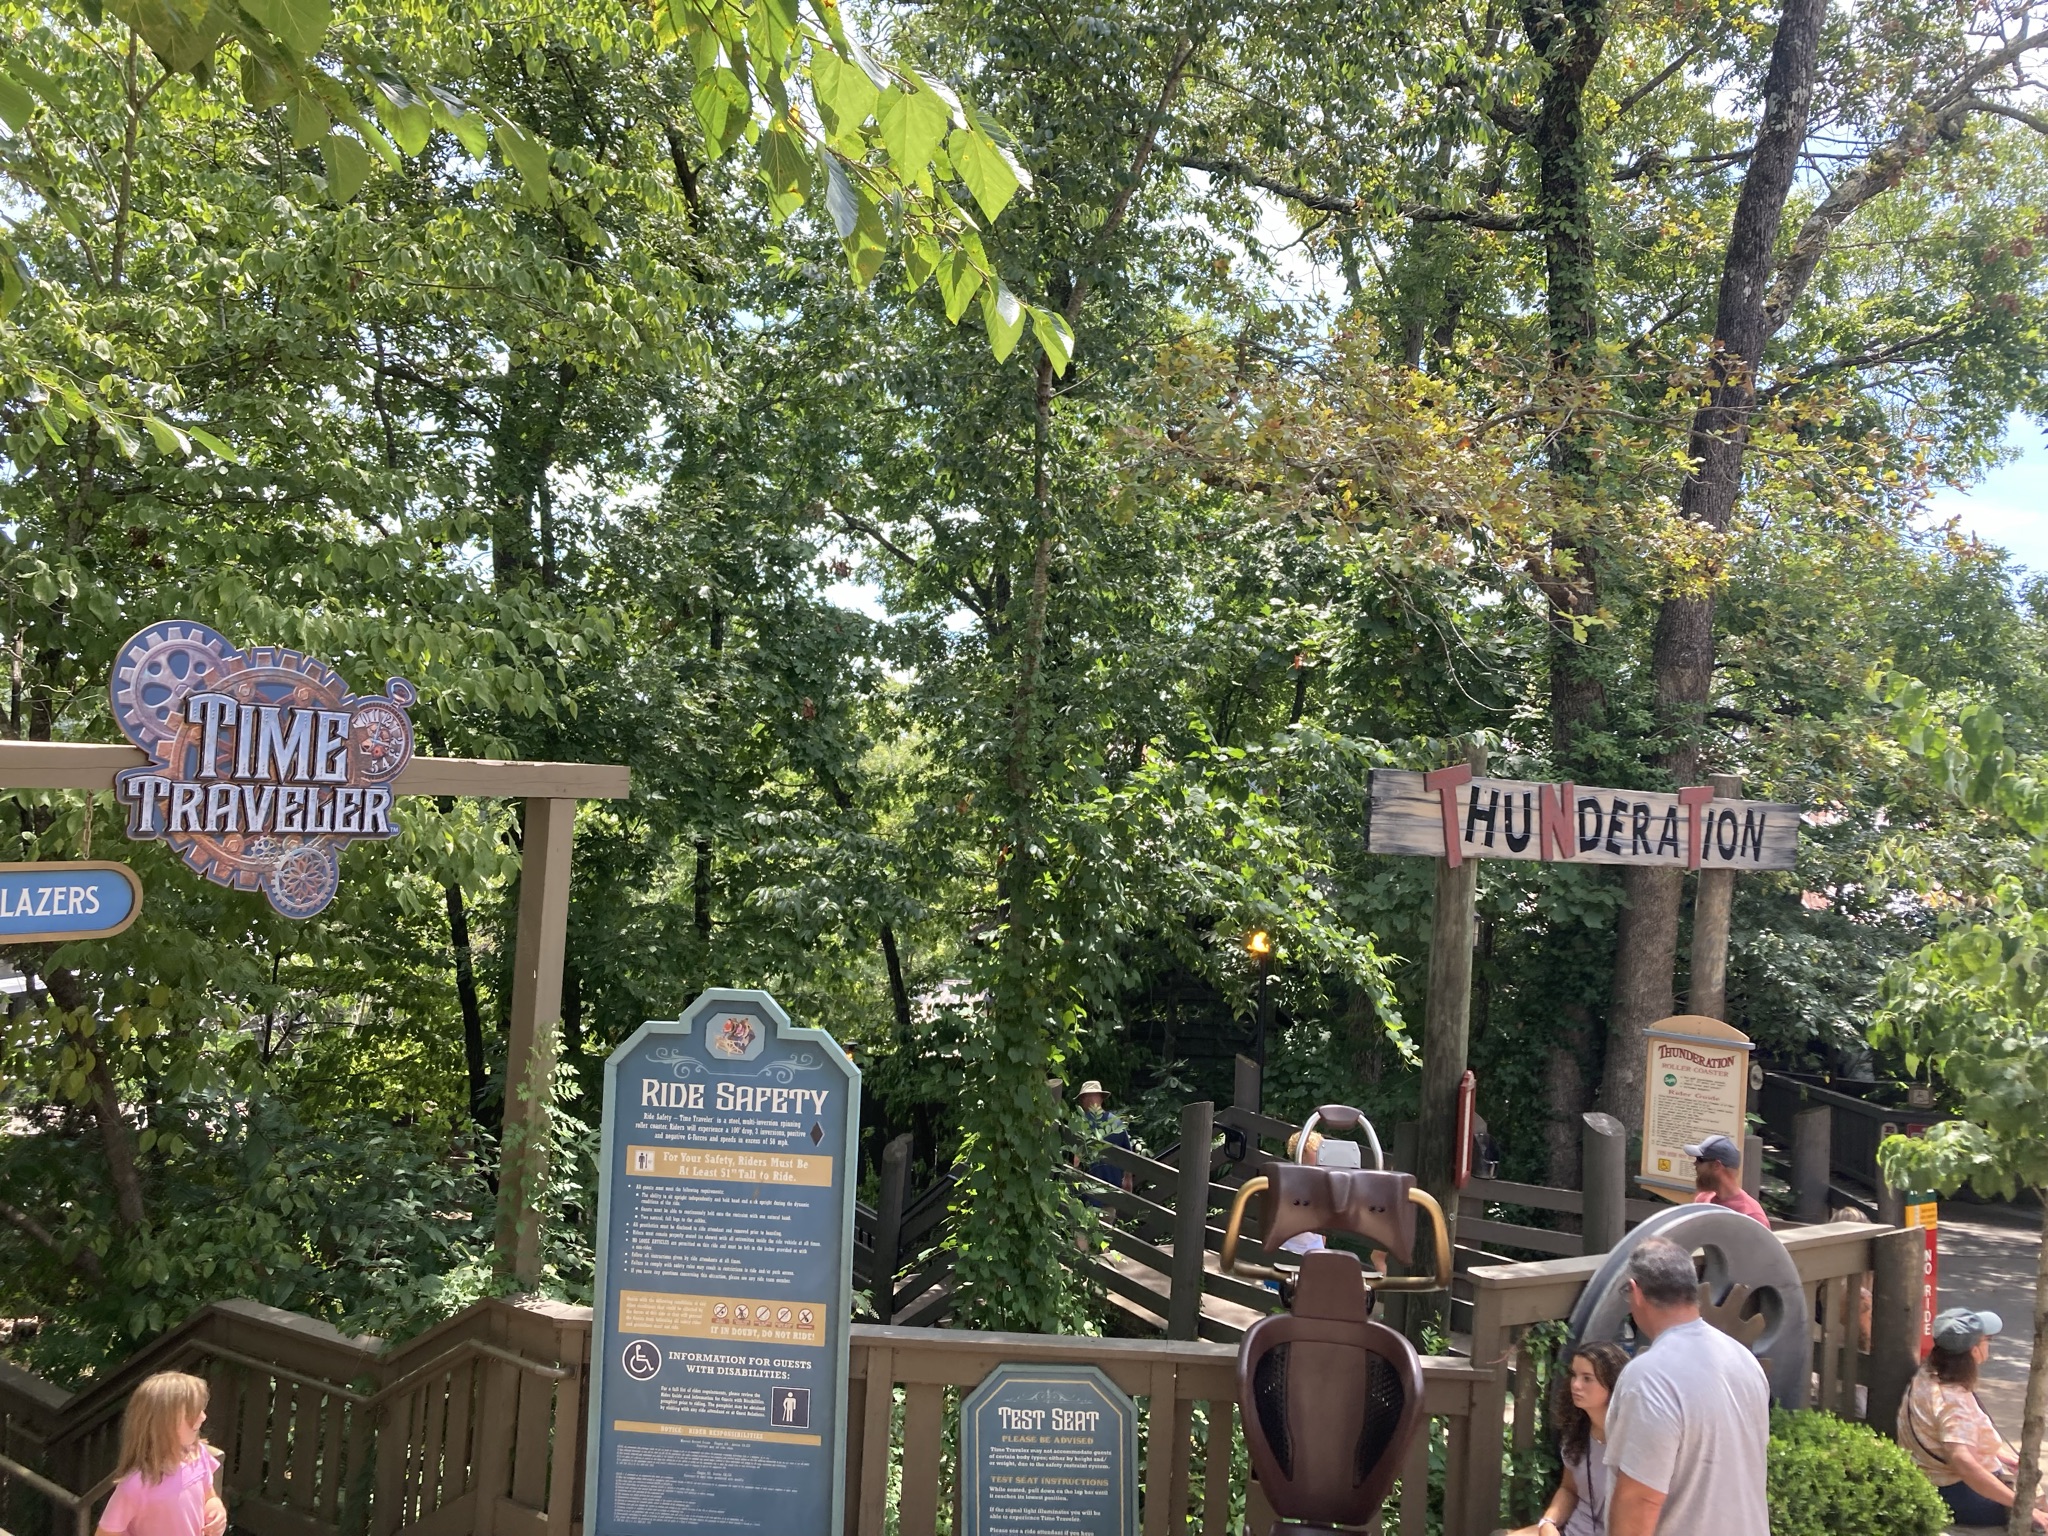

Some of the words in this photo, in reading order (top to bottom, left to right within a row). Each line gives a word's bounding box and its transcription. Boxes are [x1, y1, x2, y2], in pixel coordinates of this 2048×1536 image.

[186, 692, 352, 783] TIME
[371, 760, 379, 773] 5
[127, 776, 391, 834] TRAVELER
[1423, 763, 1767, 870] THUNDERATION
[0, 885, 100, 918] LAZERS
[1658, 1044, 1736, 1069] THUNDERATION
[1662, 1062, 1691, 1073] ROLLER
[1693, 1065, 1729, 1078] COASTER
[641, 1079, 705, 1109] RIDE
[716, 1082, 829, 1115] SAFETY
[663, 1151, 678, 1162] For
[681, 1152, 701, 1163] Your
[705, 1153, 735, 1167] Safety,
[738, 1155, 767, 1167] Riders
[771, 1157, 793, 1168] Must
[797, 1159, 809, 1169] Be
[678, 1165, 688, 1176] At
[693, 1166, 717, 1177] Least
[760, 1170, 769, 1180] to
[773, 1171, 797, 1182] Ride.
[1924, 1249, 1932, 1275] NO
[1924, 1285, 1932, 1336] RIDE
[721, 1326, 729, 1335] IN
[762, 1329, 773, 1338] DO
[775, 1330, 791, 1339] NOT
[668, 1351, 746, 1365] INFORMATION
[749, 1357, 770, 1366] FOR
[773, 1358, 812, 1369] GUESTS
[685, 1364, 714, 1374] WITH
[717, 1366, 791, 1379] DISABILITIES:
[998, 1406, 1045, 1431] TEST
[1051, 1407, 1099, 1432] SEAT
[1001, 1435, 1036, 1443] PLEASE
[1054, 1436, 1094, 1444] ADVISED
[990, 1475, 1012, 1483] TEST
[1015, 1476, 1038, 1484] SEAT
[1041, 1477, 1109, 1487] INSTRUCTIONS
